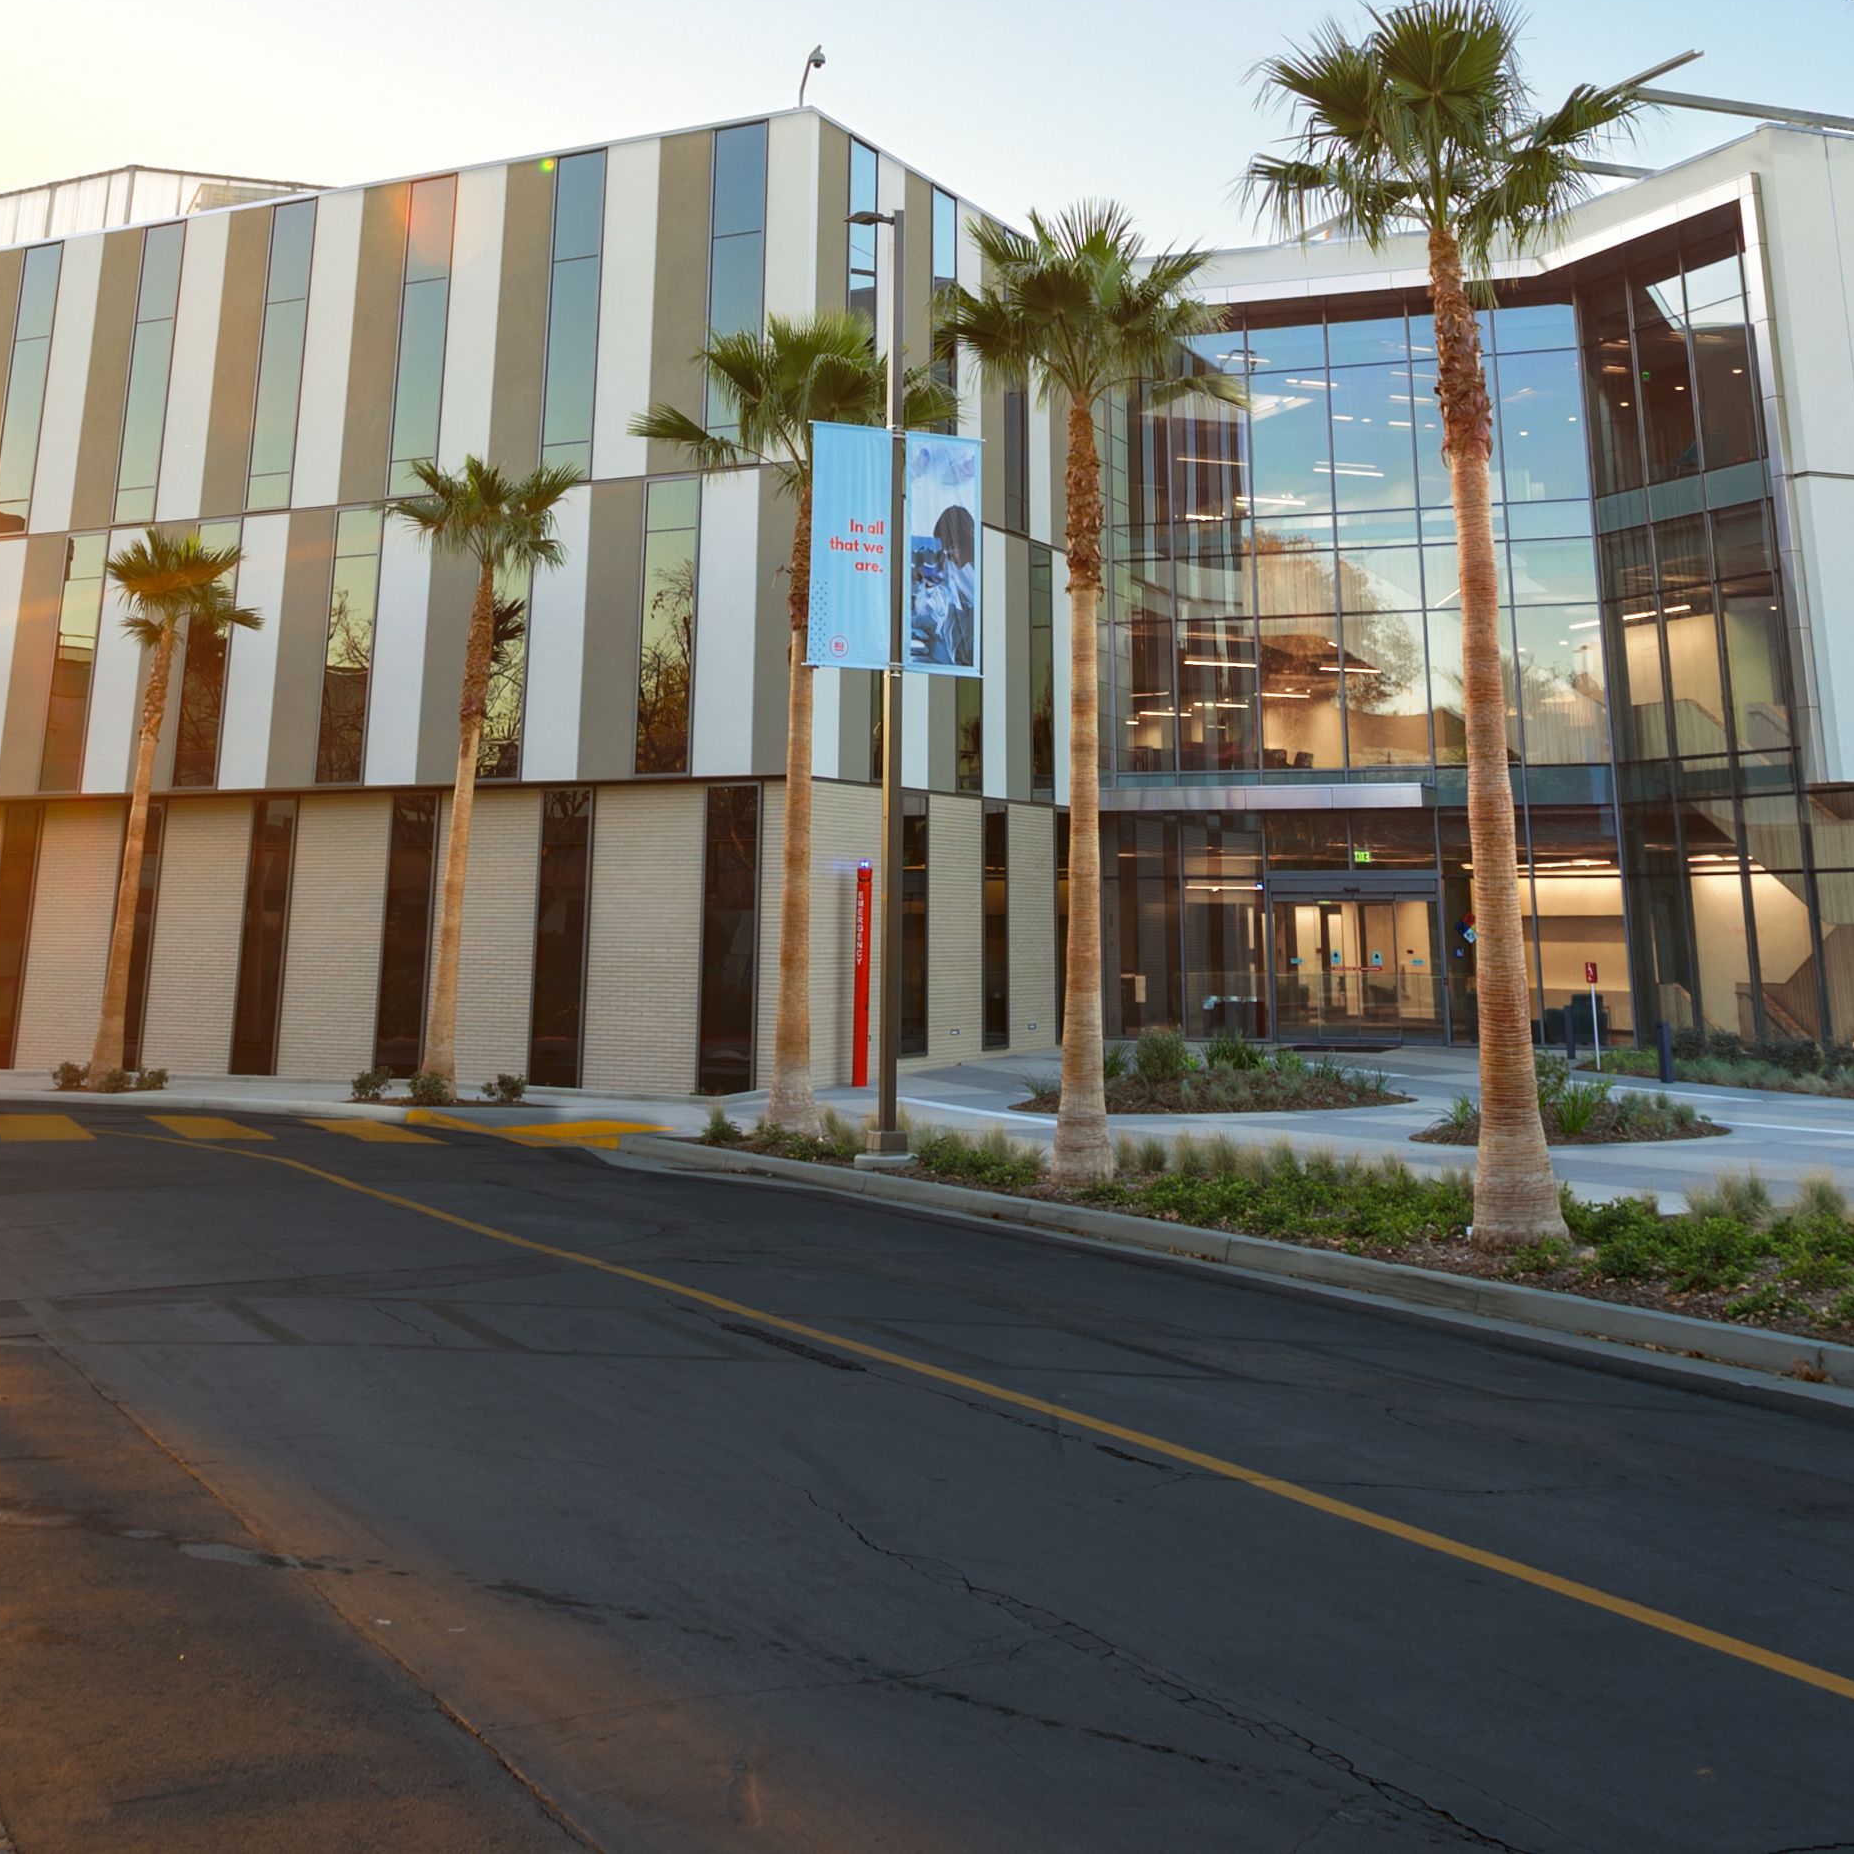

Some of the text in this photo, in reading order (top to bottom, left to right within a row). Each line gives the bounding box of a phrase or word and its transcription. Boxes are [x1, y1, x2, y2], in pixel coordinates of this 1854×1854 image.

[850, 518, 884, 535] In all
[829, 535, 884, 554] that we
[855, 561, 883, 573] are.
[856, 890, 864, 966] EMERGENCY
